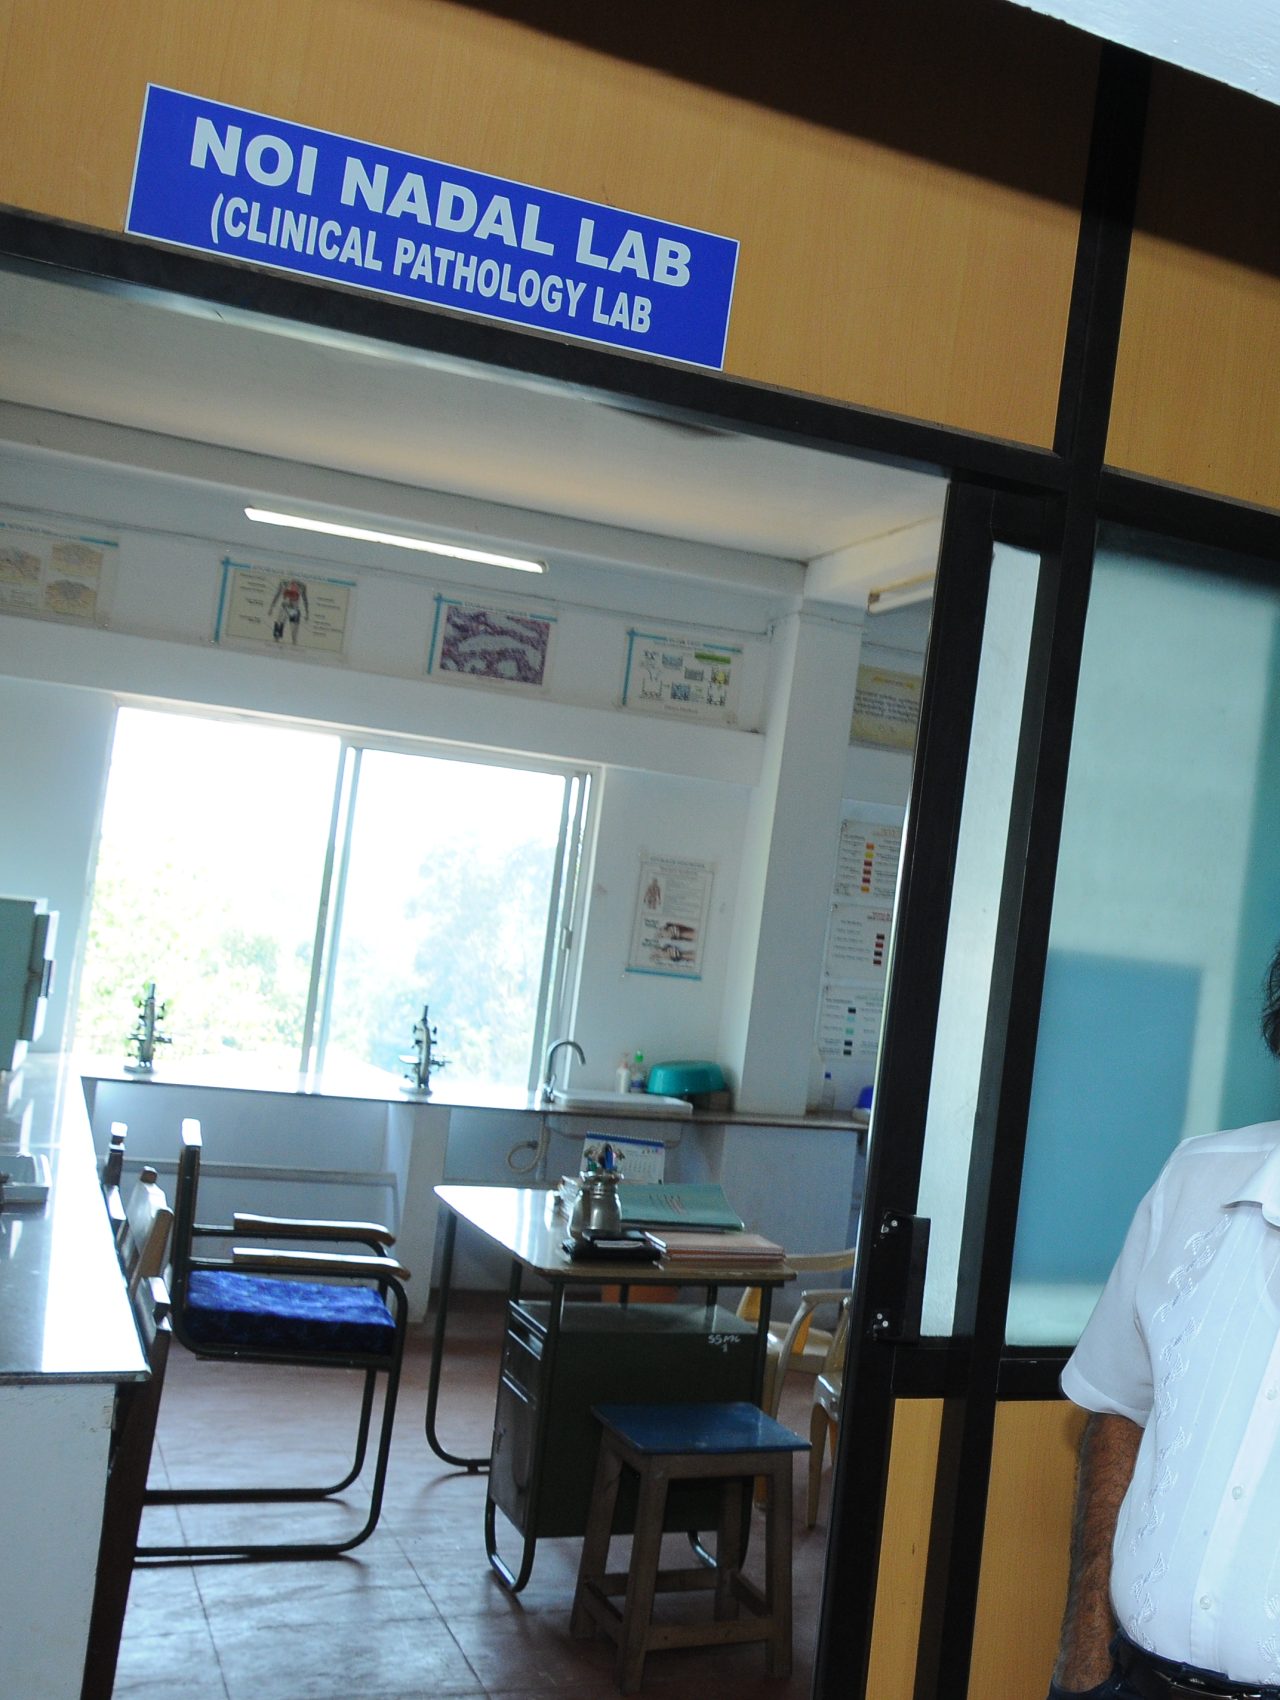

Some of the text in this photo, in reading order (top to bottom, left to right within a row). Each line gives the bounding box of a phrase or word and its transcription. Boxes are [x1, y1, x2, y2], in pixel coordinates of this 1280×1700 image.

[191, 117, 691, 287] NOI NADAL LAB
[211, 193, 652, 334] (CLINICAL PATHOLOGY LAB
